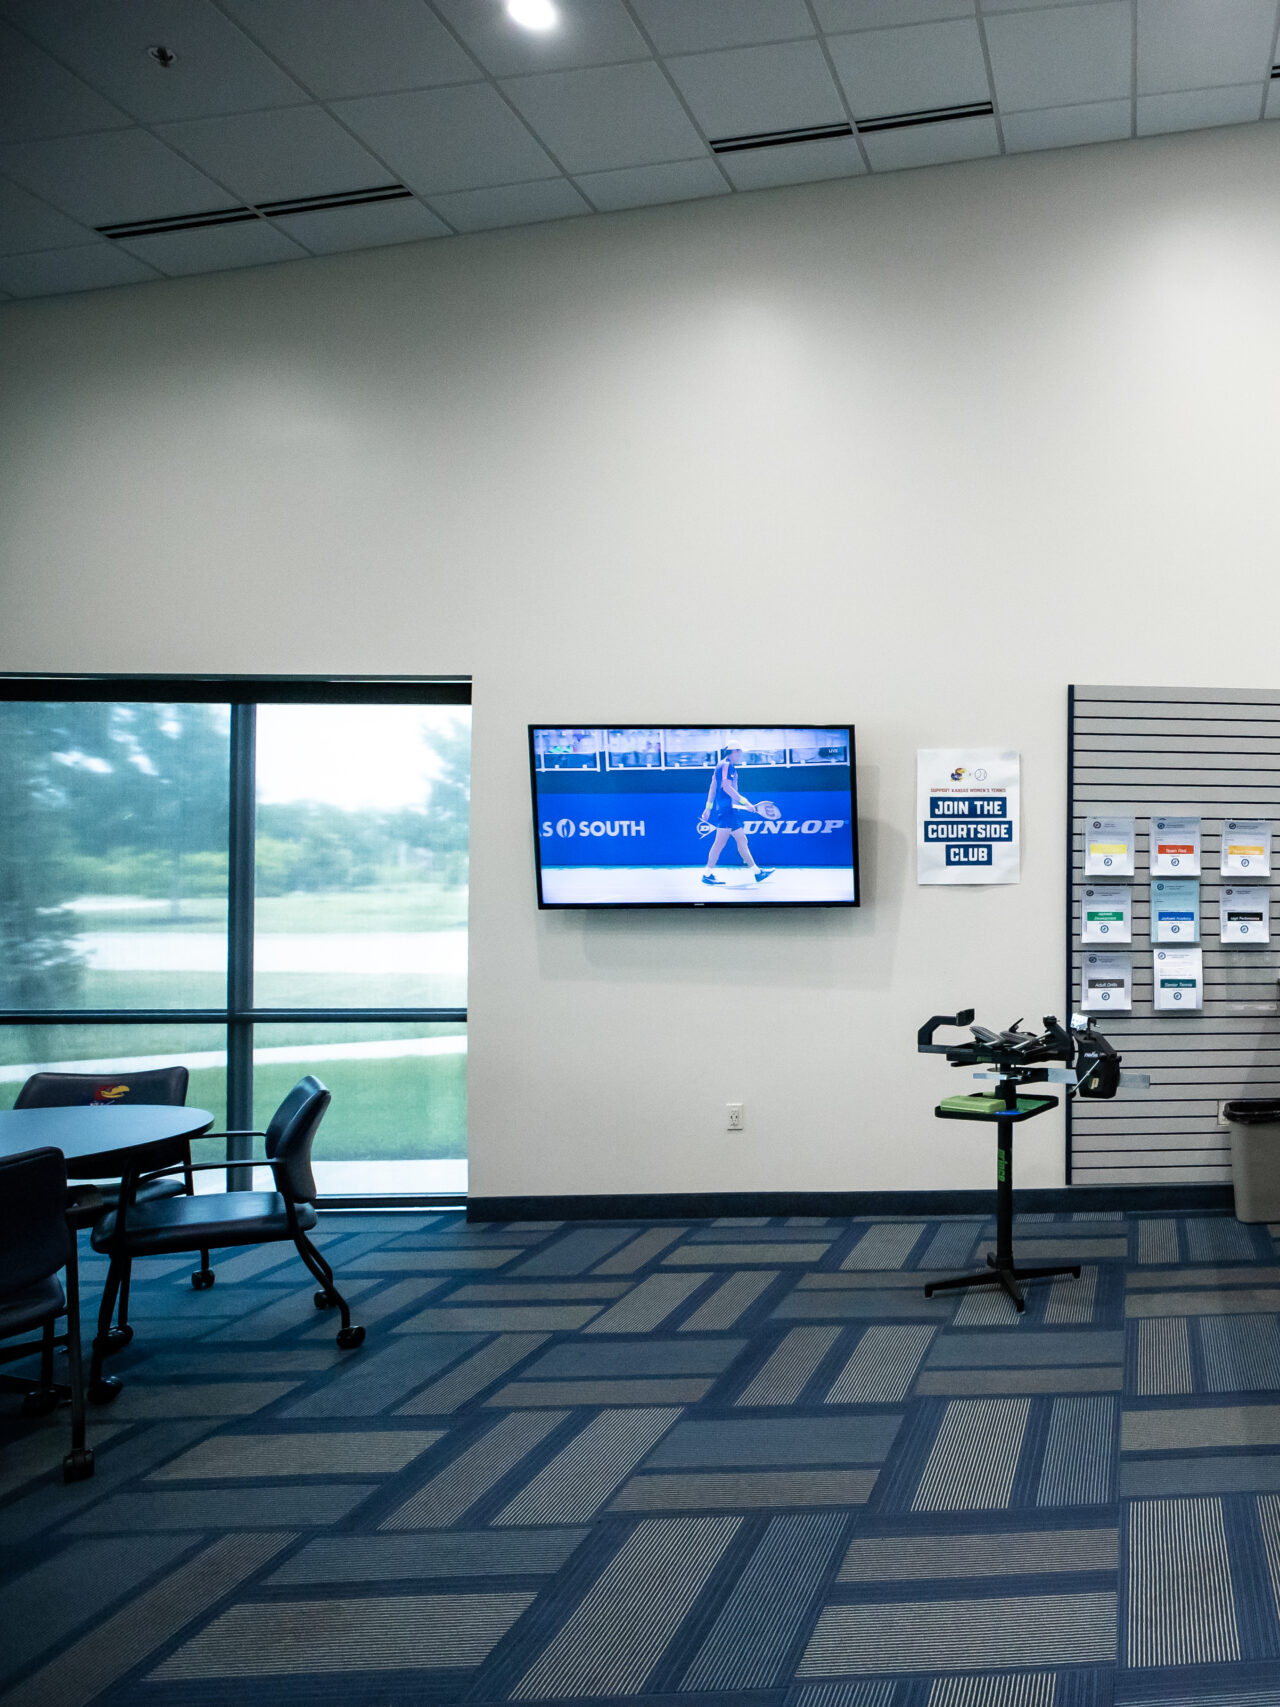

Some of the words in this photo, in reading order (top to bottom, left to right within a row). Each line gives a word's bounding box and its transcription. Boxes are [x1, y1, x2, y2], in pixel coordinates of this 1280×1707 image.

[934, 800, 969, 815] JOIN
[974, 800, 1002, 815] THE
[539, 821, 553, 837] S
[579, 820, 646, 837] SOUTH
[743, 820, 845, 835] UNLOP
[927, 824, 1009, 838] COURTSIDE
[950, 848, 988, 862] CLUB
